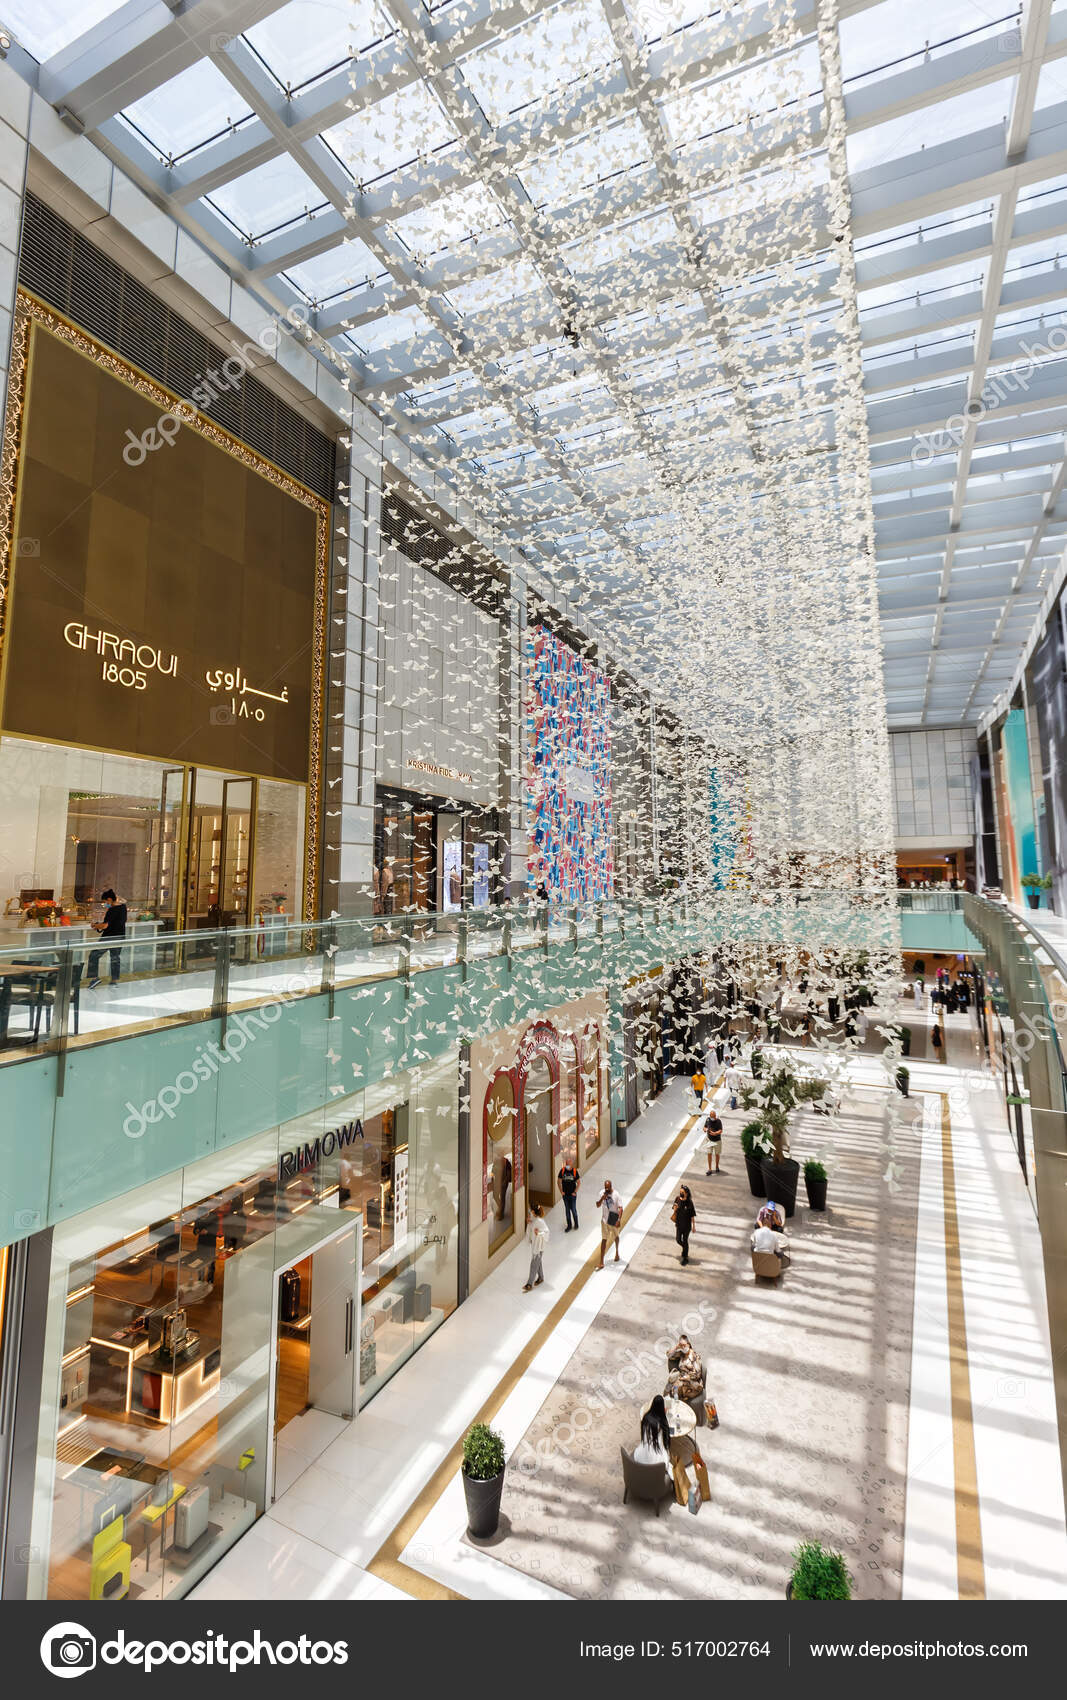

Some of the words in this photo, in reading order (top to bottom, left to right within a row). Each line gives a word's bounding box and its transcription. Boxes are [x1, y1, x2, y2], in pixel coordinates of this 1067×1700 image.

[63, 622, 178, 677] GHRAOUI
[102, 661, 147, 690] 1805
[278, 1118, 364, 1181] RIMOWA
